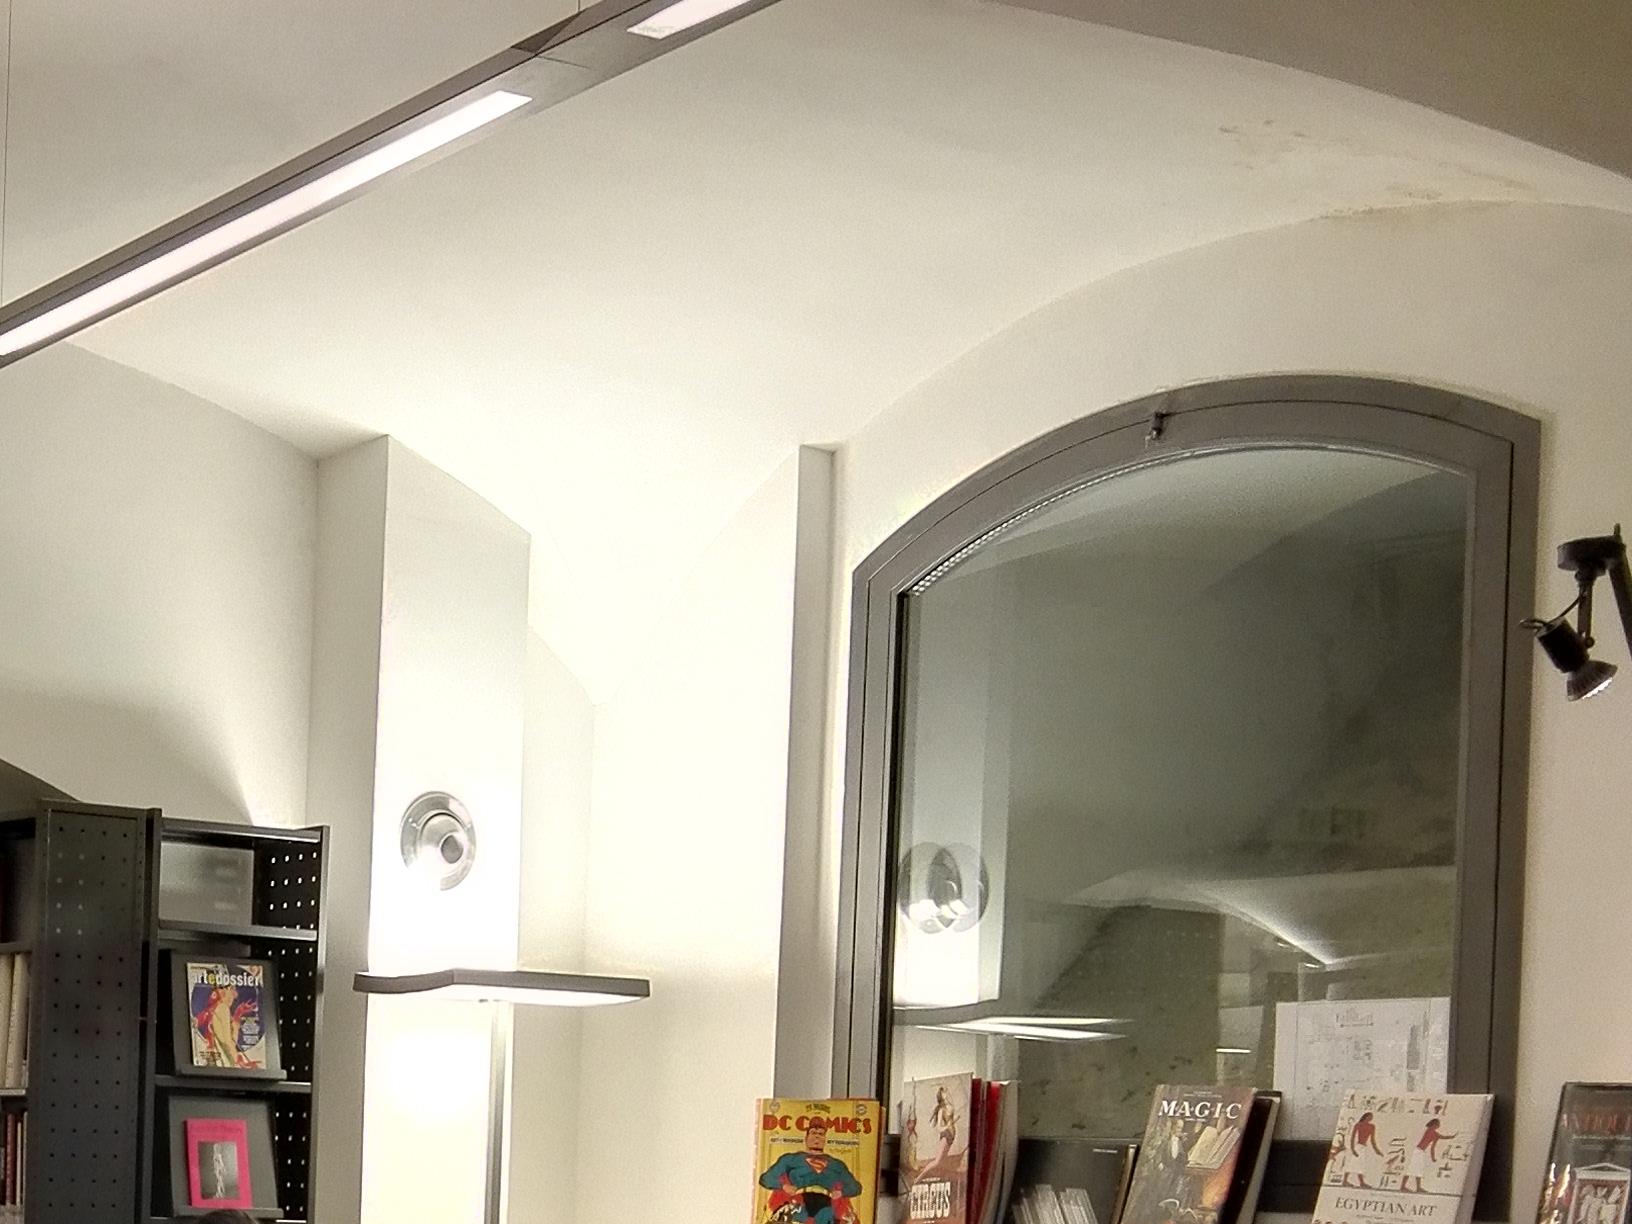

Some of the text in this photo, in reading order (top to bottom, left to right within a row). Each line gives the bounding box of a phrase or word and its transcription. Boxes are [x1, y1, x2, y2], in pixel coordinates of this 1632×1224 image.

[763, 1114, 873, 1135] DC COMICS
[1335, 1197, 1437, 1216] EGYPTIAN ART
